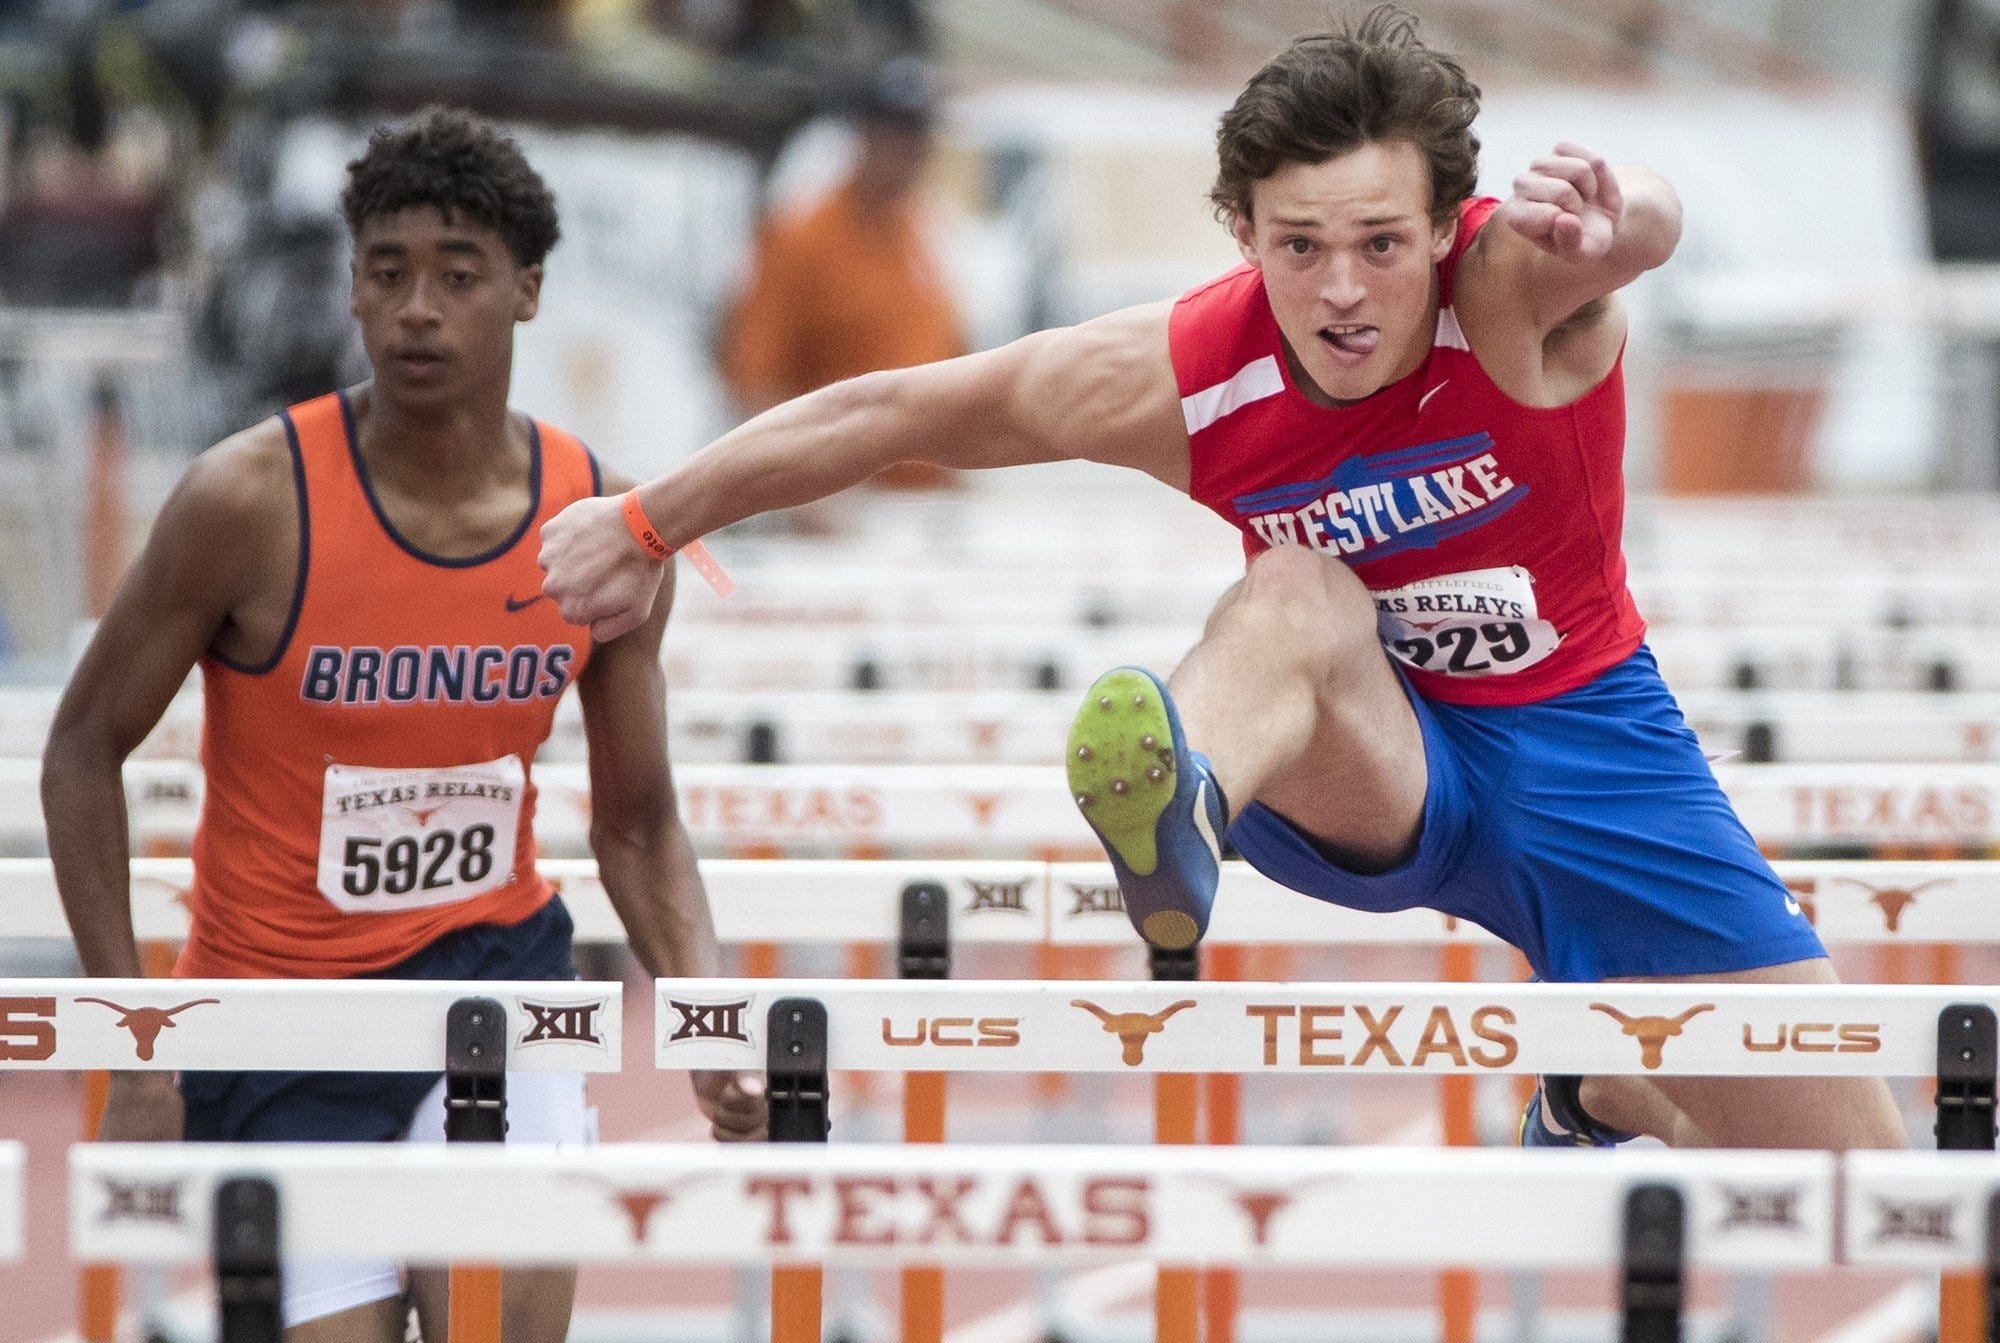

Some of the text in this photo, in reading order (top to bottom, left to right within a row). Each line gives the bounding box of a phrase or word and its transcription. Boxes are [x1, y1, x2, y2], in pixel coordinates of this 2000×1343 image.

[1249, 454, 1514, 558] WESTLAKE
[1412, 578, 1503, 593] LITTLEFIELD
[1415, 594, 1525, 620] RELAYS
[302, 644, 574, 706] BRONCOS
[337, 781, 512, 813] TEXAS RELAYS
[341, 822, 495, 898] 5928
[521, 1001, 600, 1044] XII
[669, 999, 748, 1042] XII
[882, 1004, 1881, 1068] UCS TEXAS UCS
[743, 1173, 1155, 1248] TEXAS
